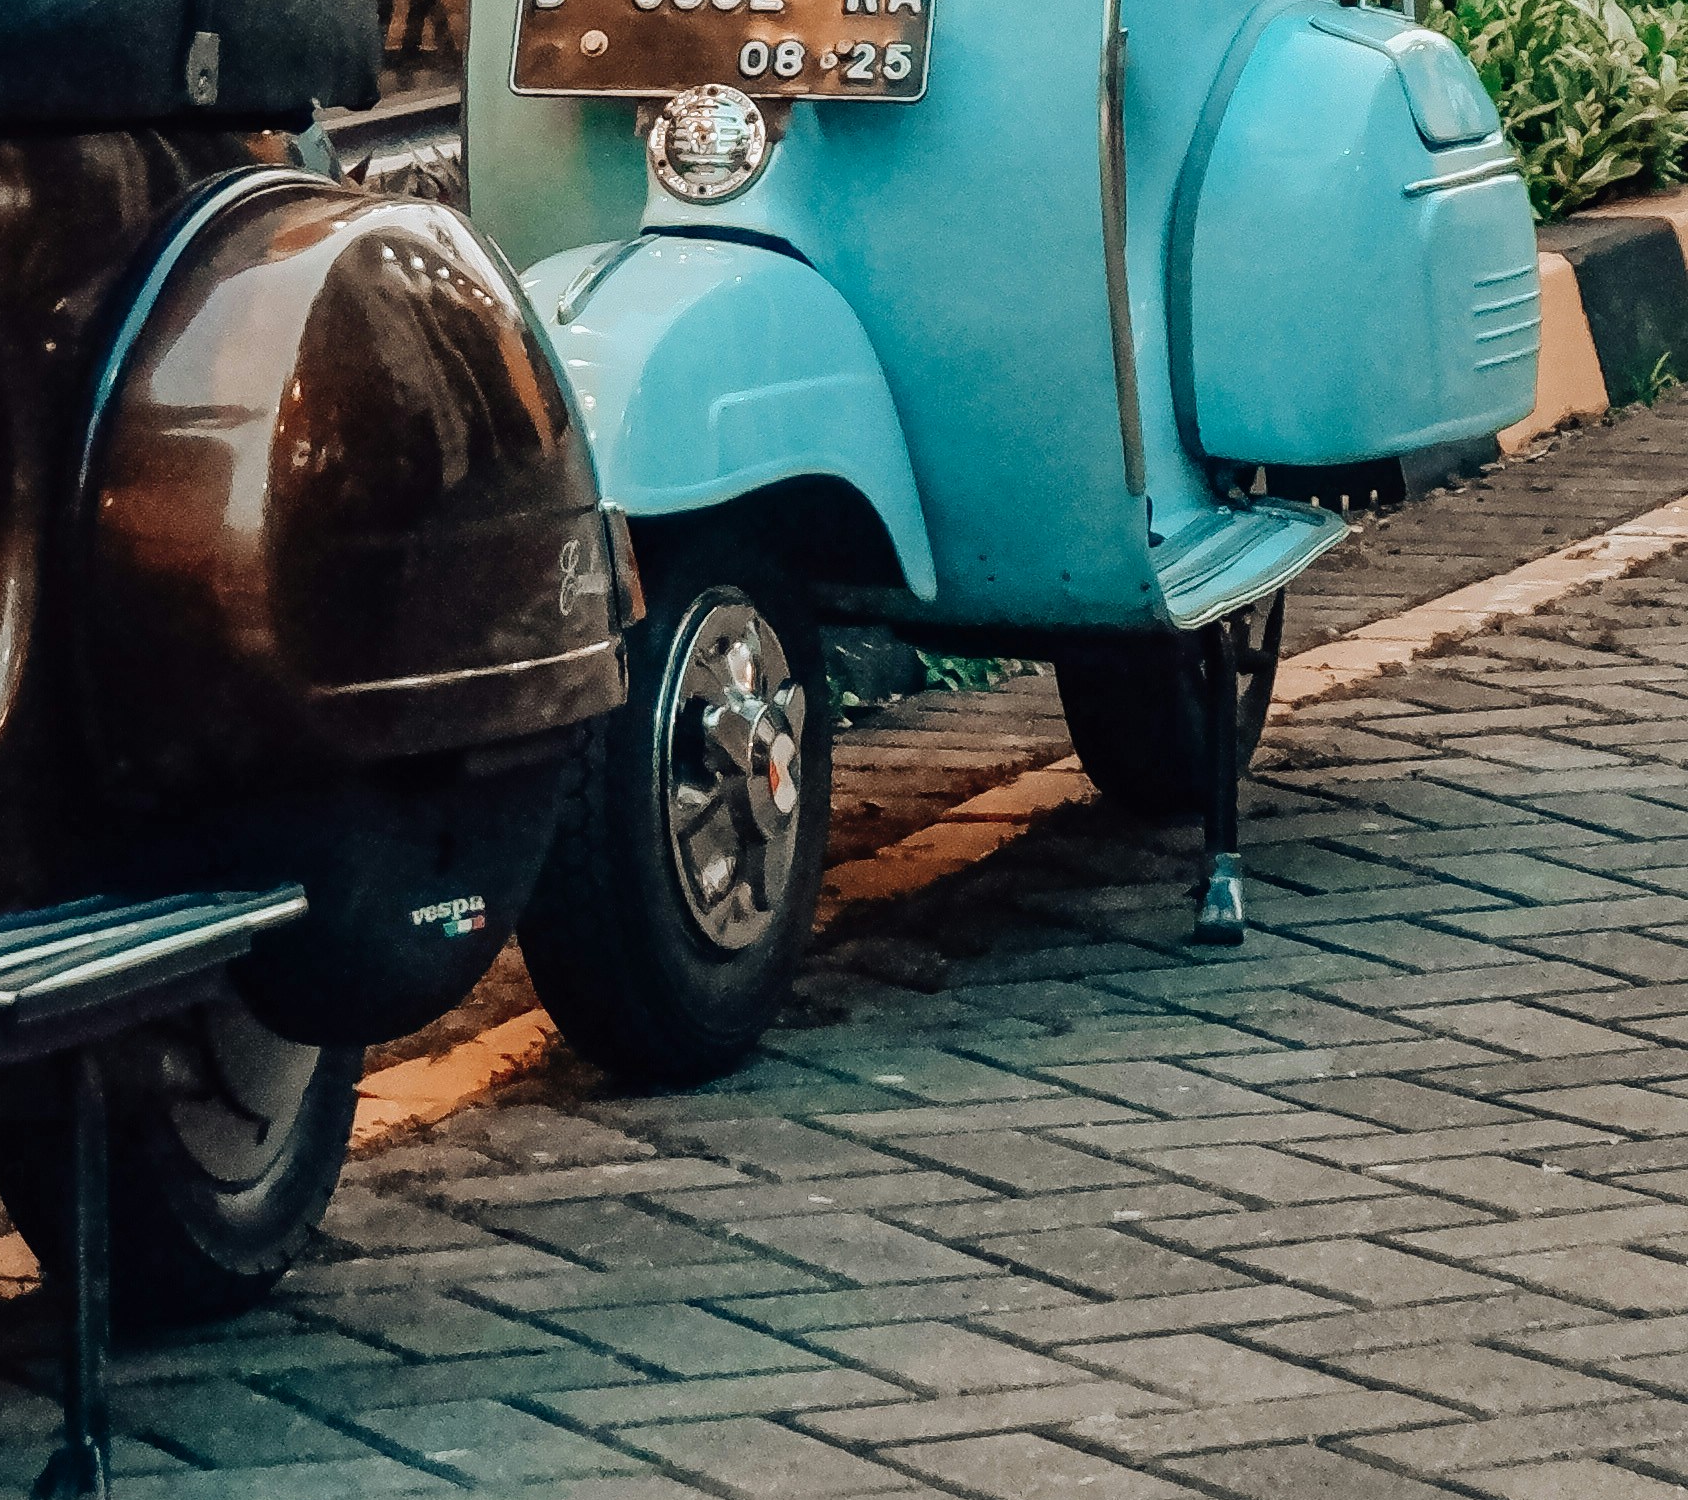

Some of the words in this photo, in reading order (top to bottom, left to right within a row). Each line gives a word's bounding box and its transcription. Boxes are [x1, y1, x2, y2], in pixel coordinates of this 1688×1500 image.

[739, 40, 805, 78] 08
[846, 42, 913, 80] 25
[411, 895, 486, 926] vespa
